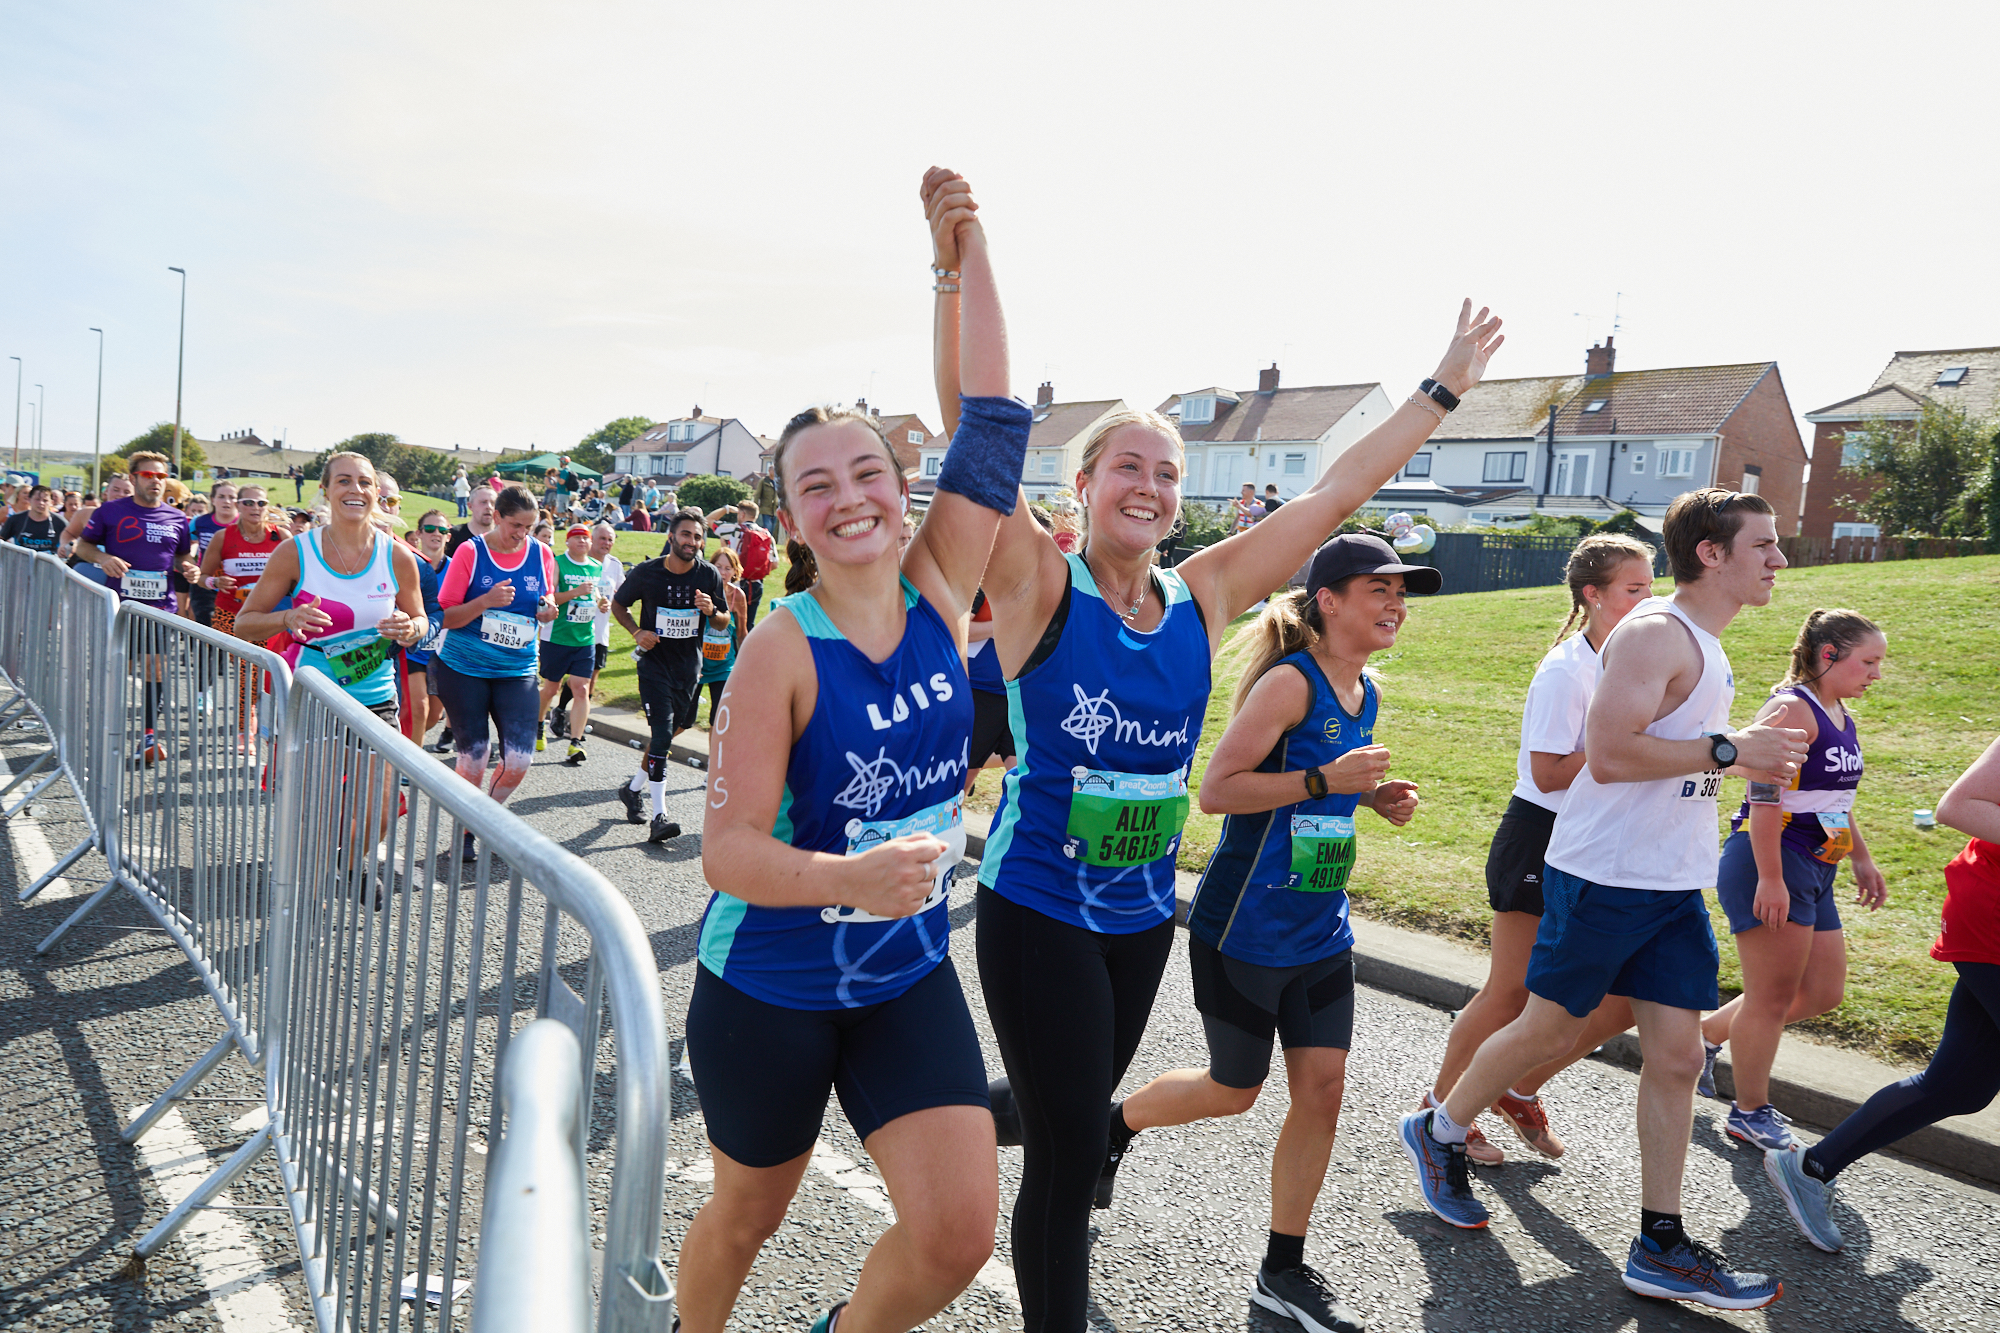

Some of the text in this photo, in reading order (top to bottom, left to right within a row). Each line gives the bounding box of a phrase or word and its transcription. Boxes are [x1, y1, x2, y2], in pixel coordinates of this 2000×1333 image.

[145, 522, 174, 532] Blood
[22, 536, 53, 545] Team
[145, 535, 162, 544] UK
[129, 579, 160, 589] MARTYN
[499, 622, 518, 636] IREN
[666, 618, 691, 628] PARAM
[493, 632, 521, 647] 33634
[666, 628, 690, 637] 22793
[866, 672, 953, 731] LOIS
[1114, 715, 1190, 748] mind
[895, 736, 969, 798] mind
[1118, 780, 1142, 790] great
[1147, 780, 1168, 790] north
[916, 813, 937, 828] north
[1115, 805, 1162, 832] ALIX
[1098, 832, 1162, 862] 54615
[1316, 841, 1352, 865] EMMA
[1308, 865, 1347, 889] 49191
